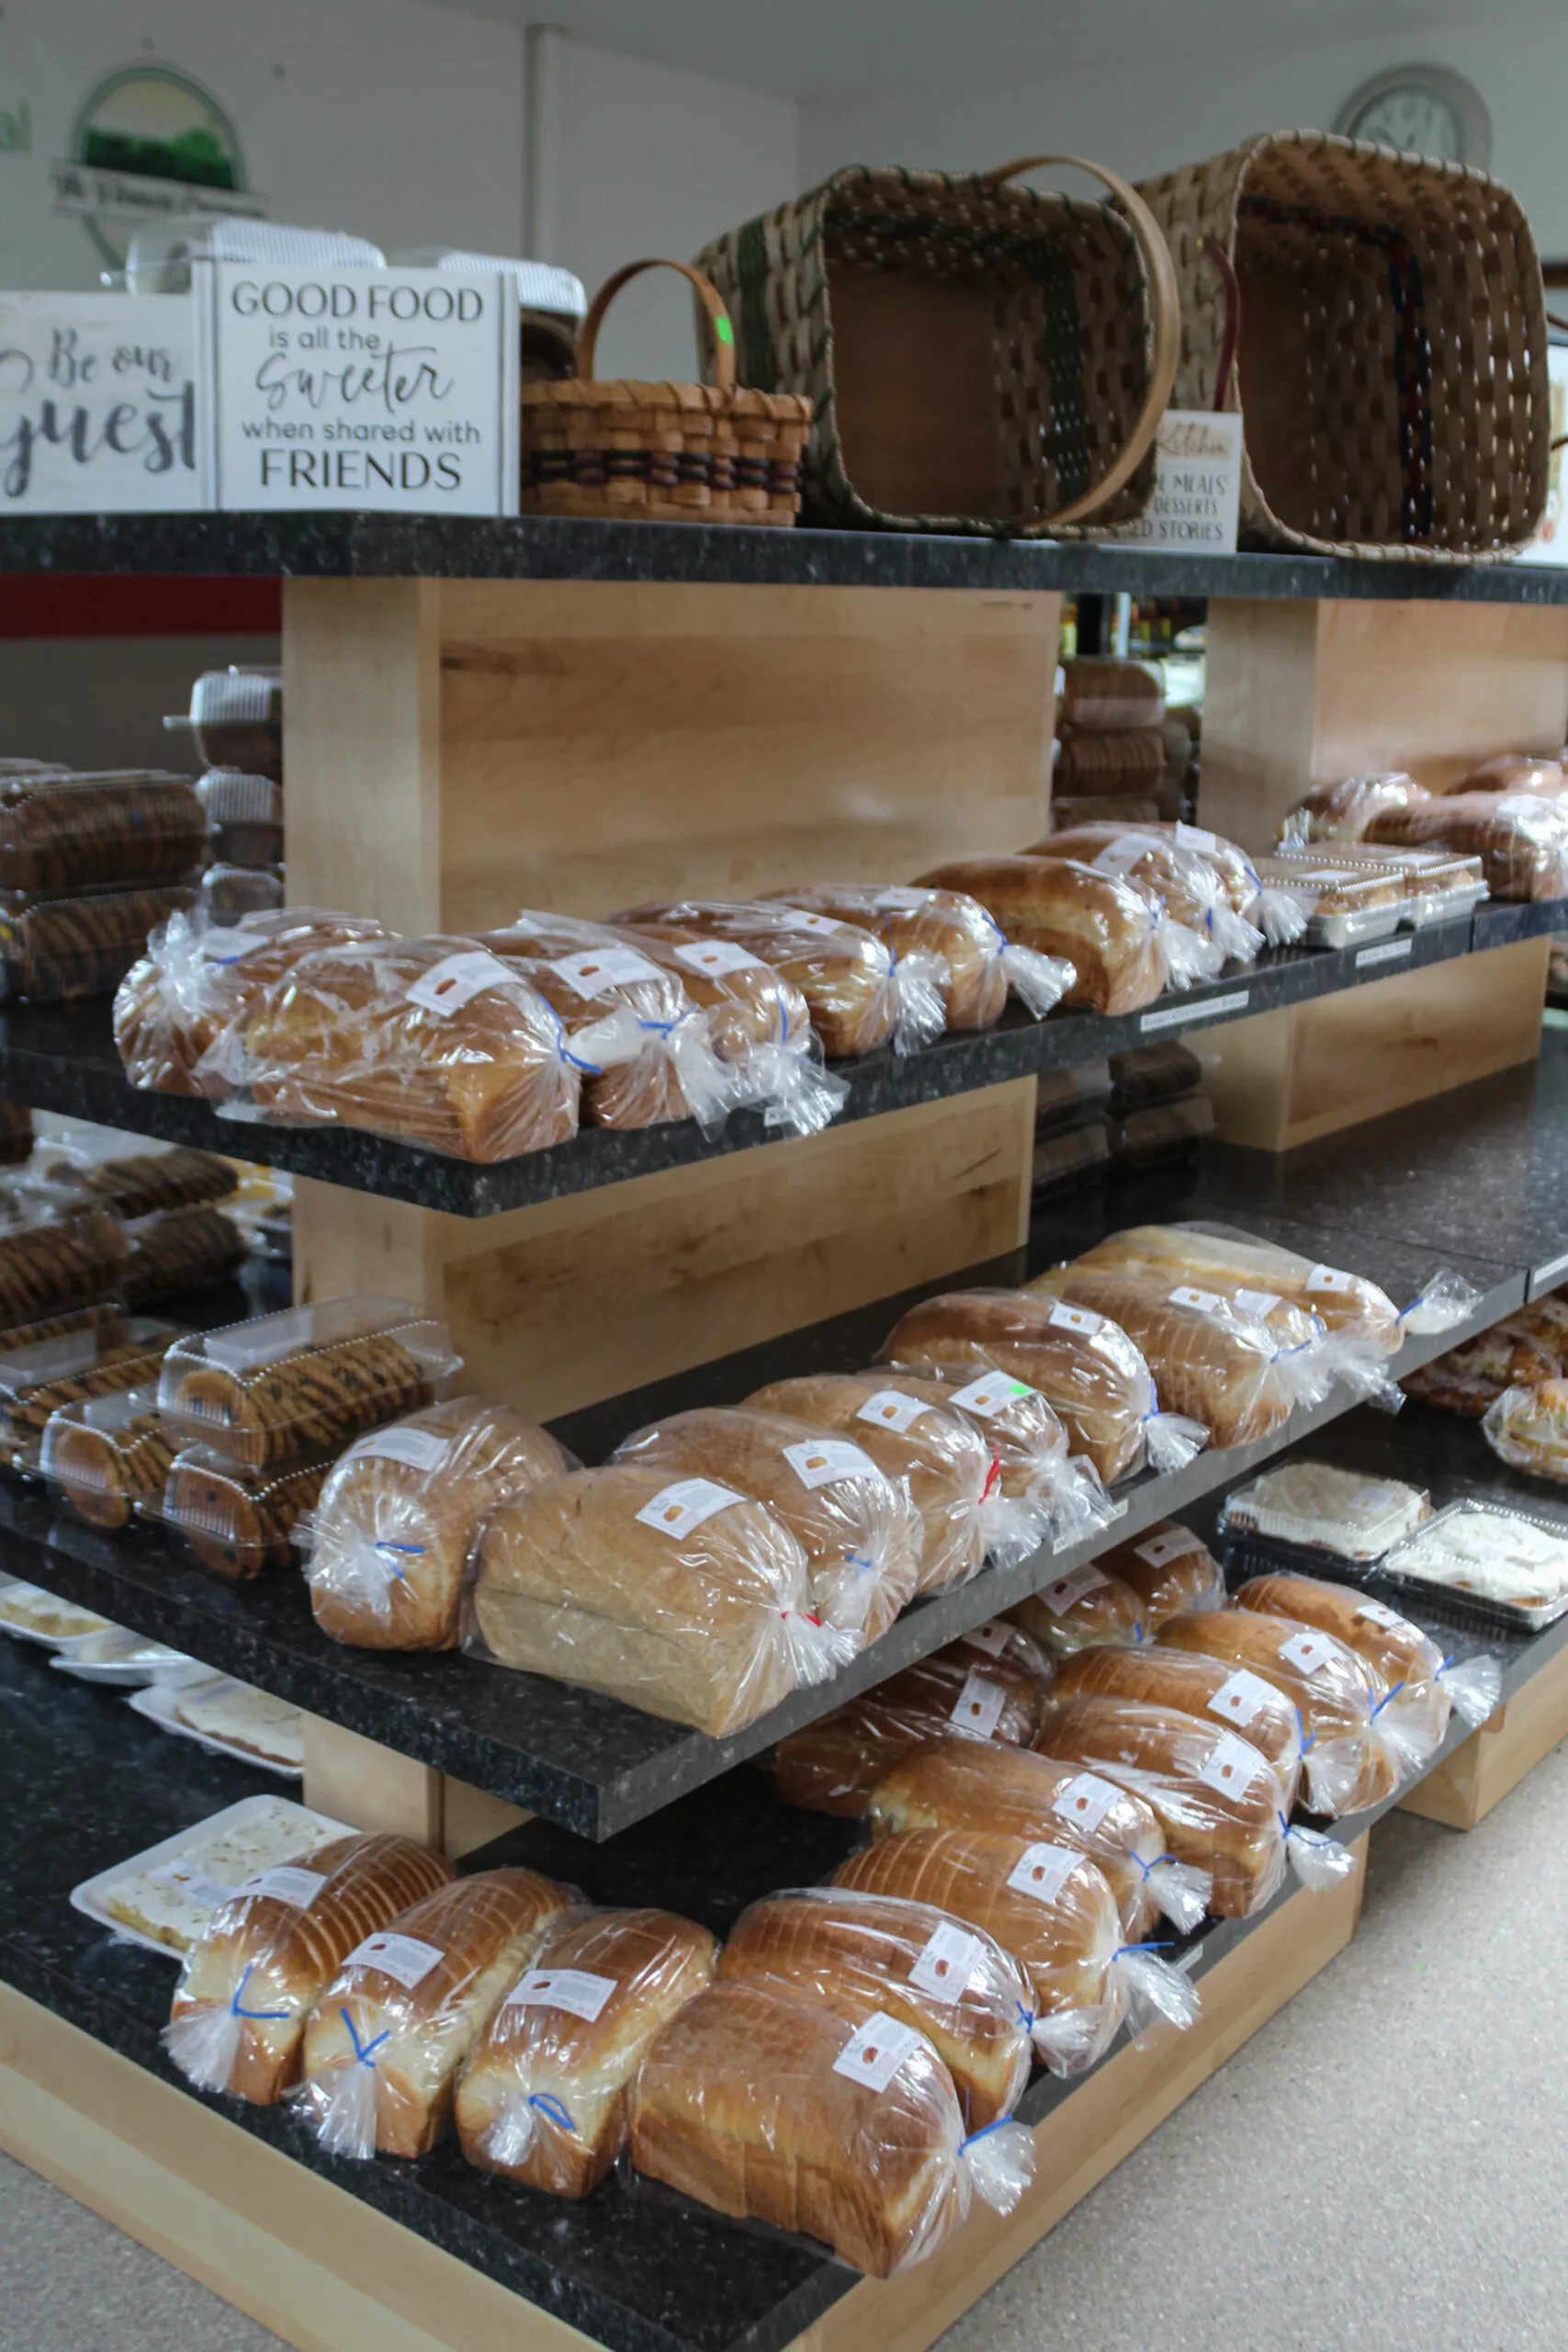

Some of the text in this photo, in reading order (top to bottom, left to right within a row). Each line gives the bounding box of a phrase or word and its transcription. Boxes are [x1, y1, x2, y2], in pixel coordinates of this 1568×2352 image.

[231, 280, 484, 322] GOOD FOOD
[269, 323, 382, 351] is all the
[49, 326, 97, 390] Be
[241, 415, 481, 445] when shared with
[260, 447, 463, 492] FRIENDS
[1158, 517, 1224, 541] STORIES
